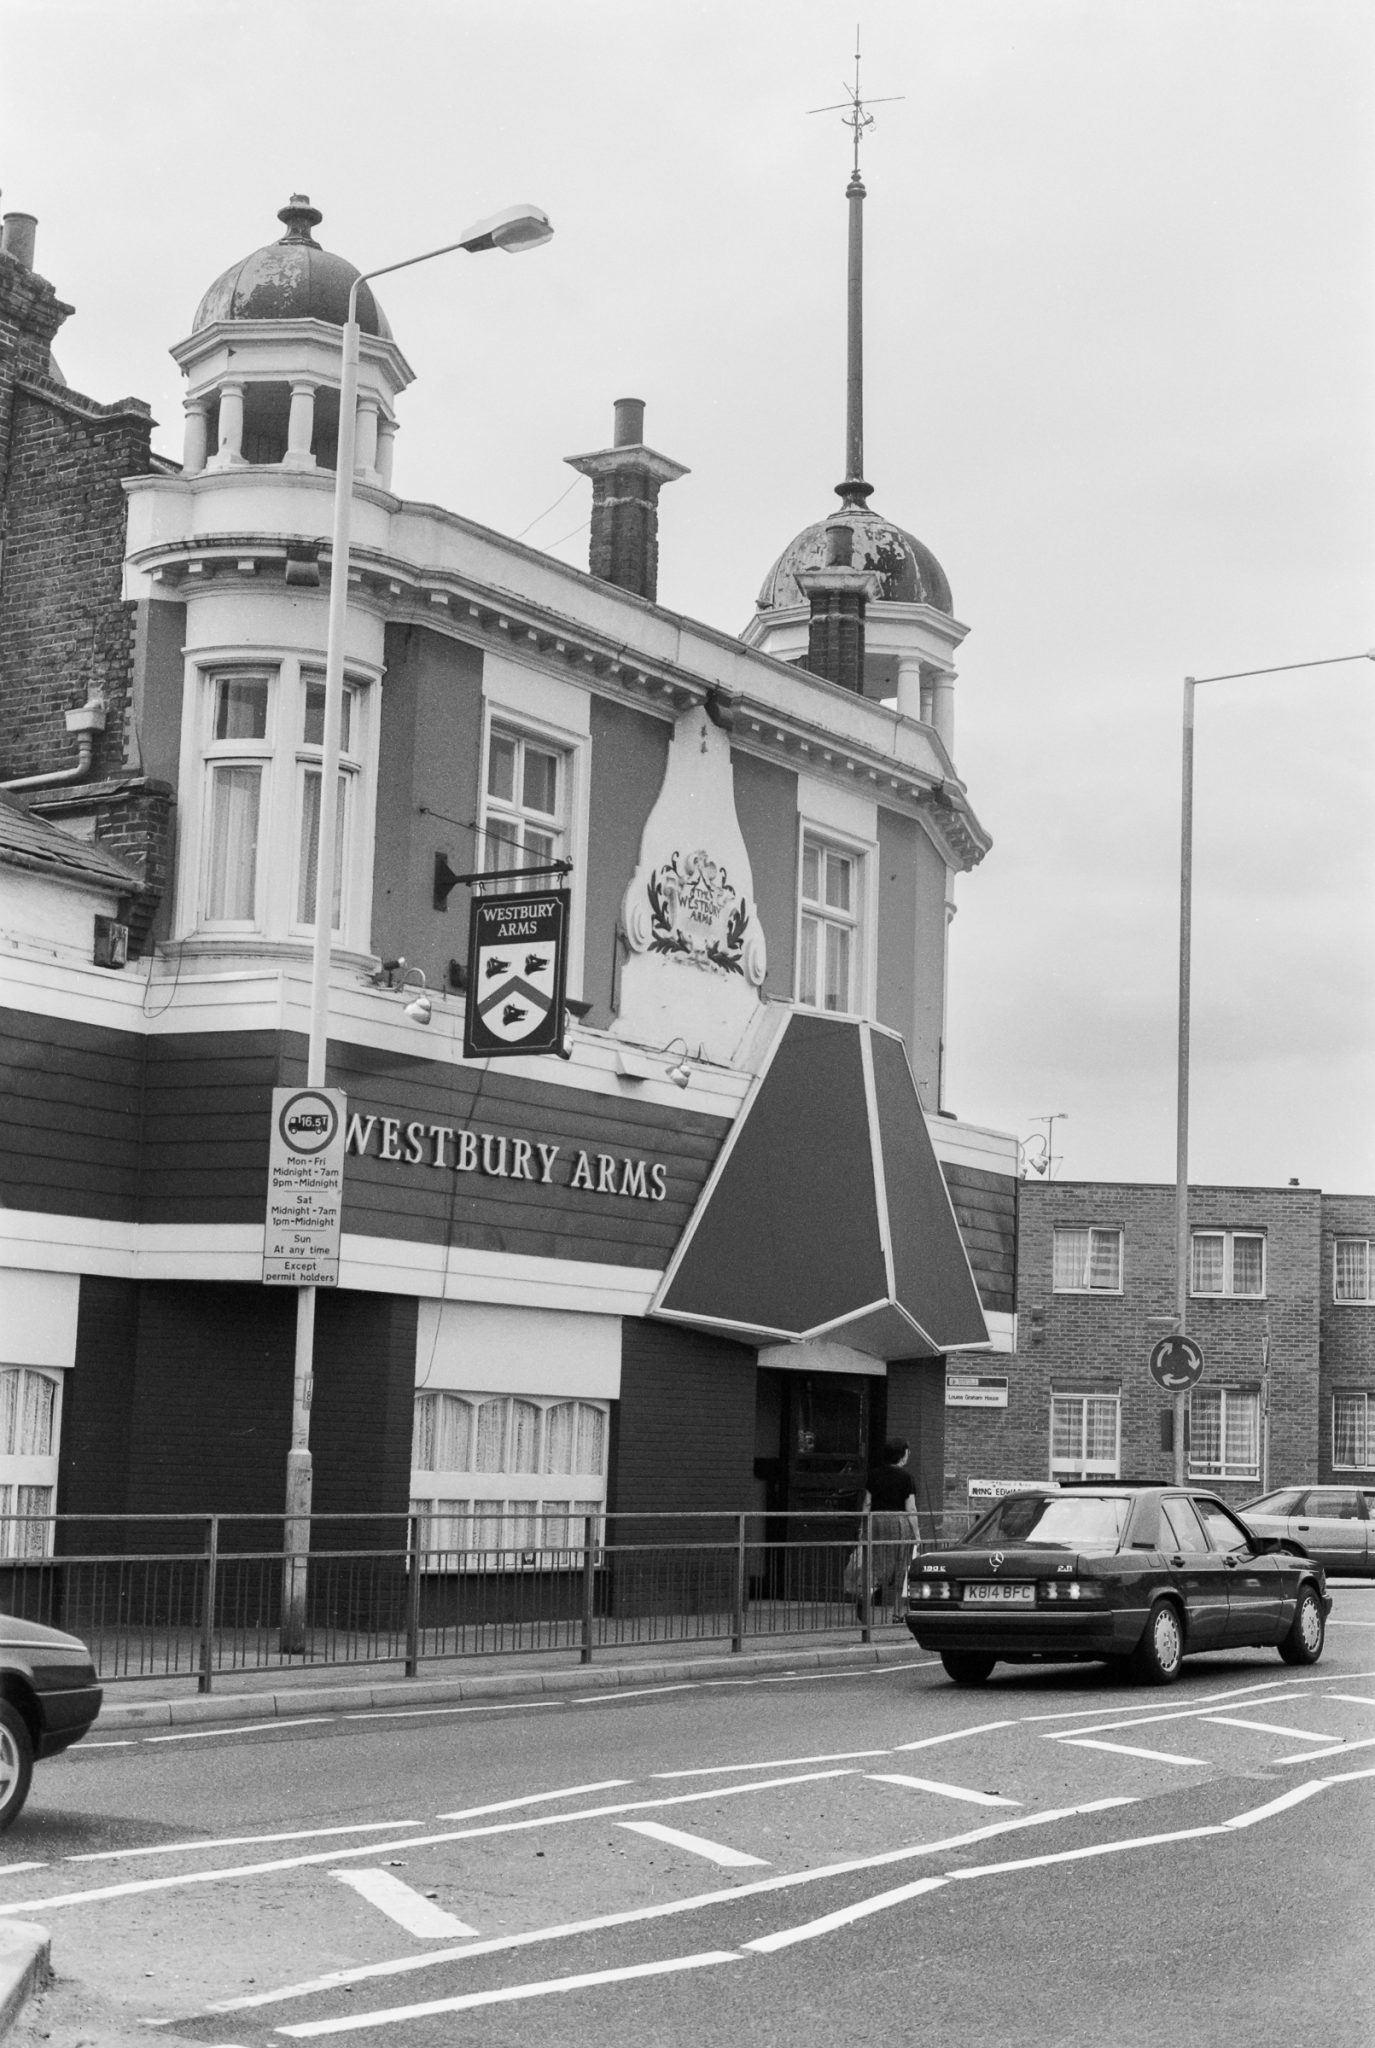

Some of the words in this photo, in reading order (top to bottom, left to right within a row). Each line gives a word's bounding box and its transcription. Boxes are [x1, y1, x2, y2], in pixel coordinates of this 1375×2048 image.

[483, 903, 556, 922] WESTBURY
[497, 920, 537, 937] ARMS
[345, 1112, 560, 1184] WESTBURY
[570, 1149, 667, 1201] ARMS
[273, 1167, 312, 1178] Midnight
[320, 1167, 339, 1177] 7am
[296, 1195, 312, 1205] Sat
[271, 1206, 310, 1217] Midnight
[318, 1206, 337, 1216] 7am
[294, 1234, 312, 1243] Sun
[273, 1244, 284, 1254] At
[289, 1247, 305, 1256] any
[310, 1245, 330, 1255] time
[284, 1261, 317, 1271] Except
[266, 1272, 296, 1282] permit
[300, 1272, 335, 1282] holders
[968, 1586, 1000, 1599] K814
[1002, 1586, 1031, 1599] BFC
